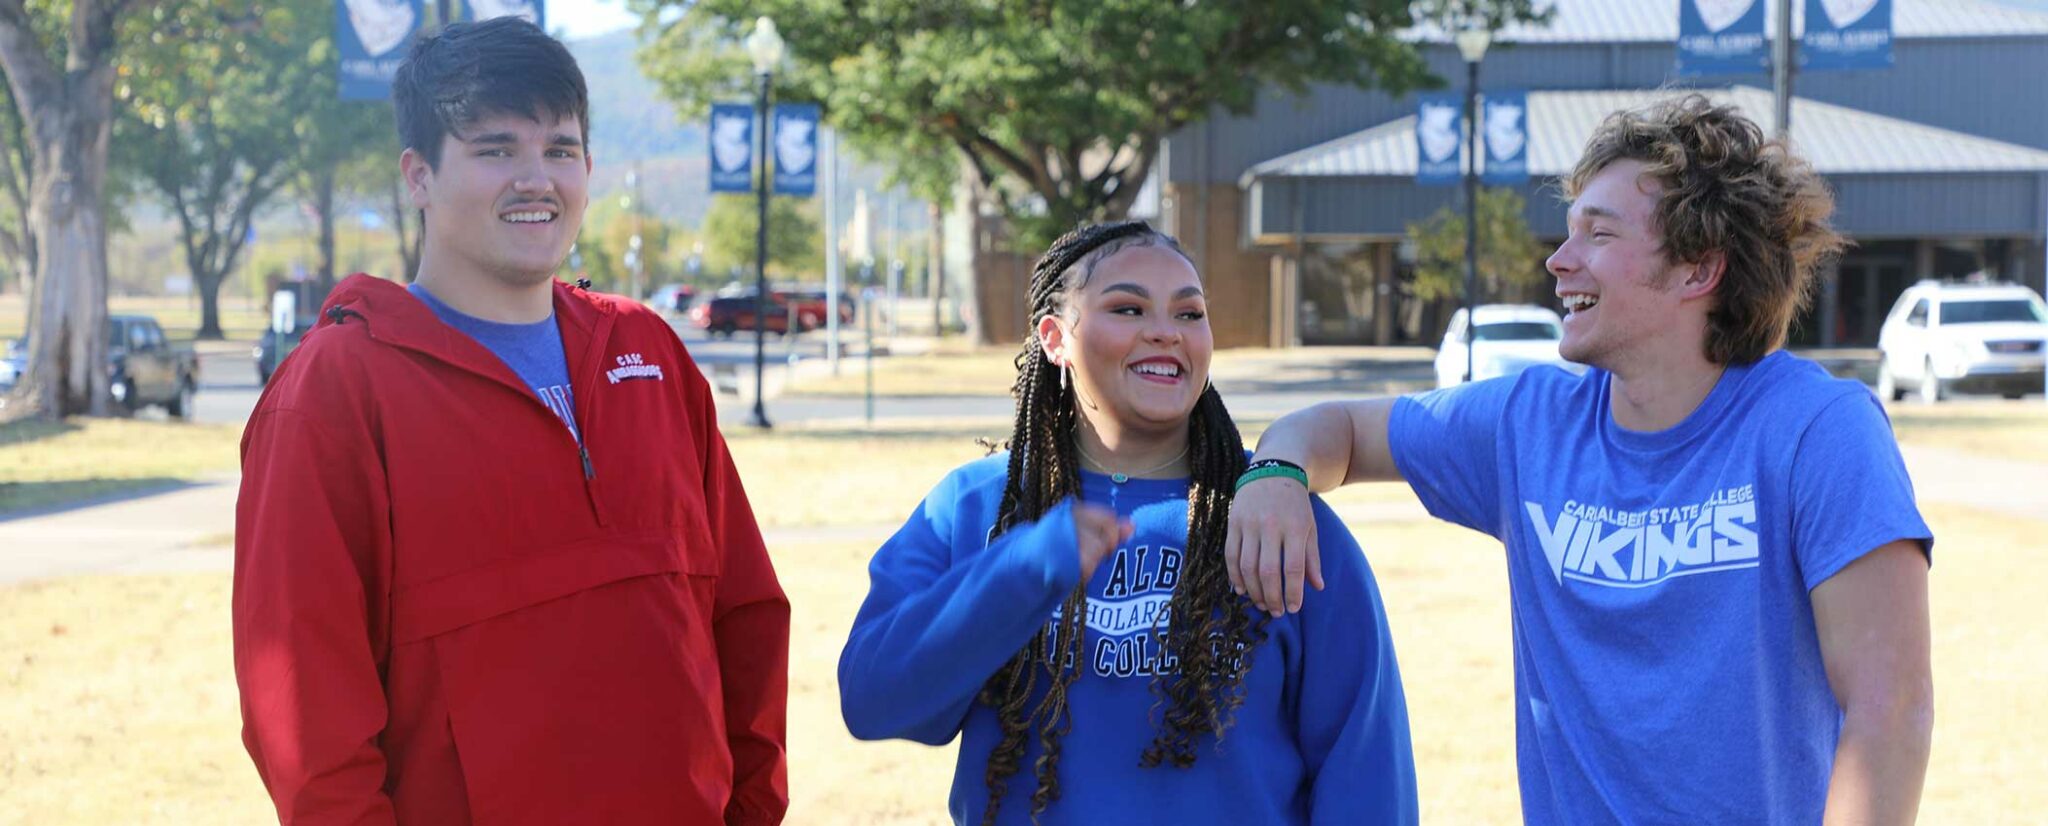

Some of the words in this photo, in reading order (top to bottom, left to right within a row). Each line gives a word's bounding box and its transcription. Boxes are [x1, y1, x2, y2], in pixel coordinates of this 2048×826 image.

[1649, 504, 1700, 525] STATE
[1701, 484, 1754, 512] LLEGE
[1525, 499, 1760, 587] VIKINGS
[1103, 544, 1184, 599] ALB
[1084, 599, 1172, 632] HOLARS
